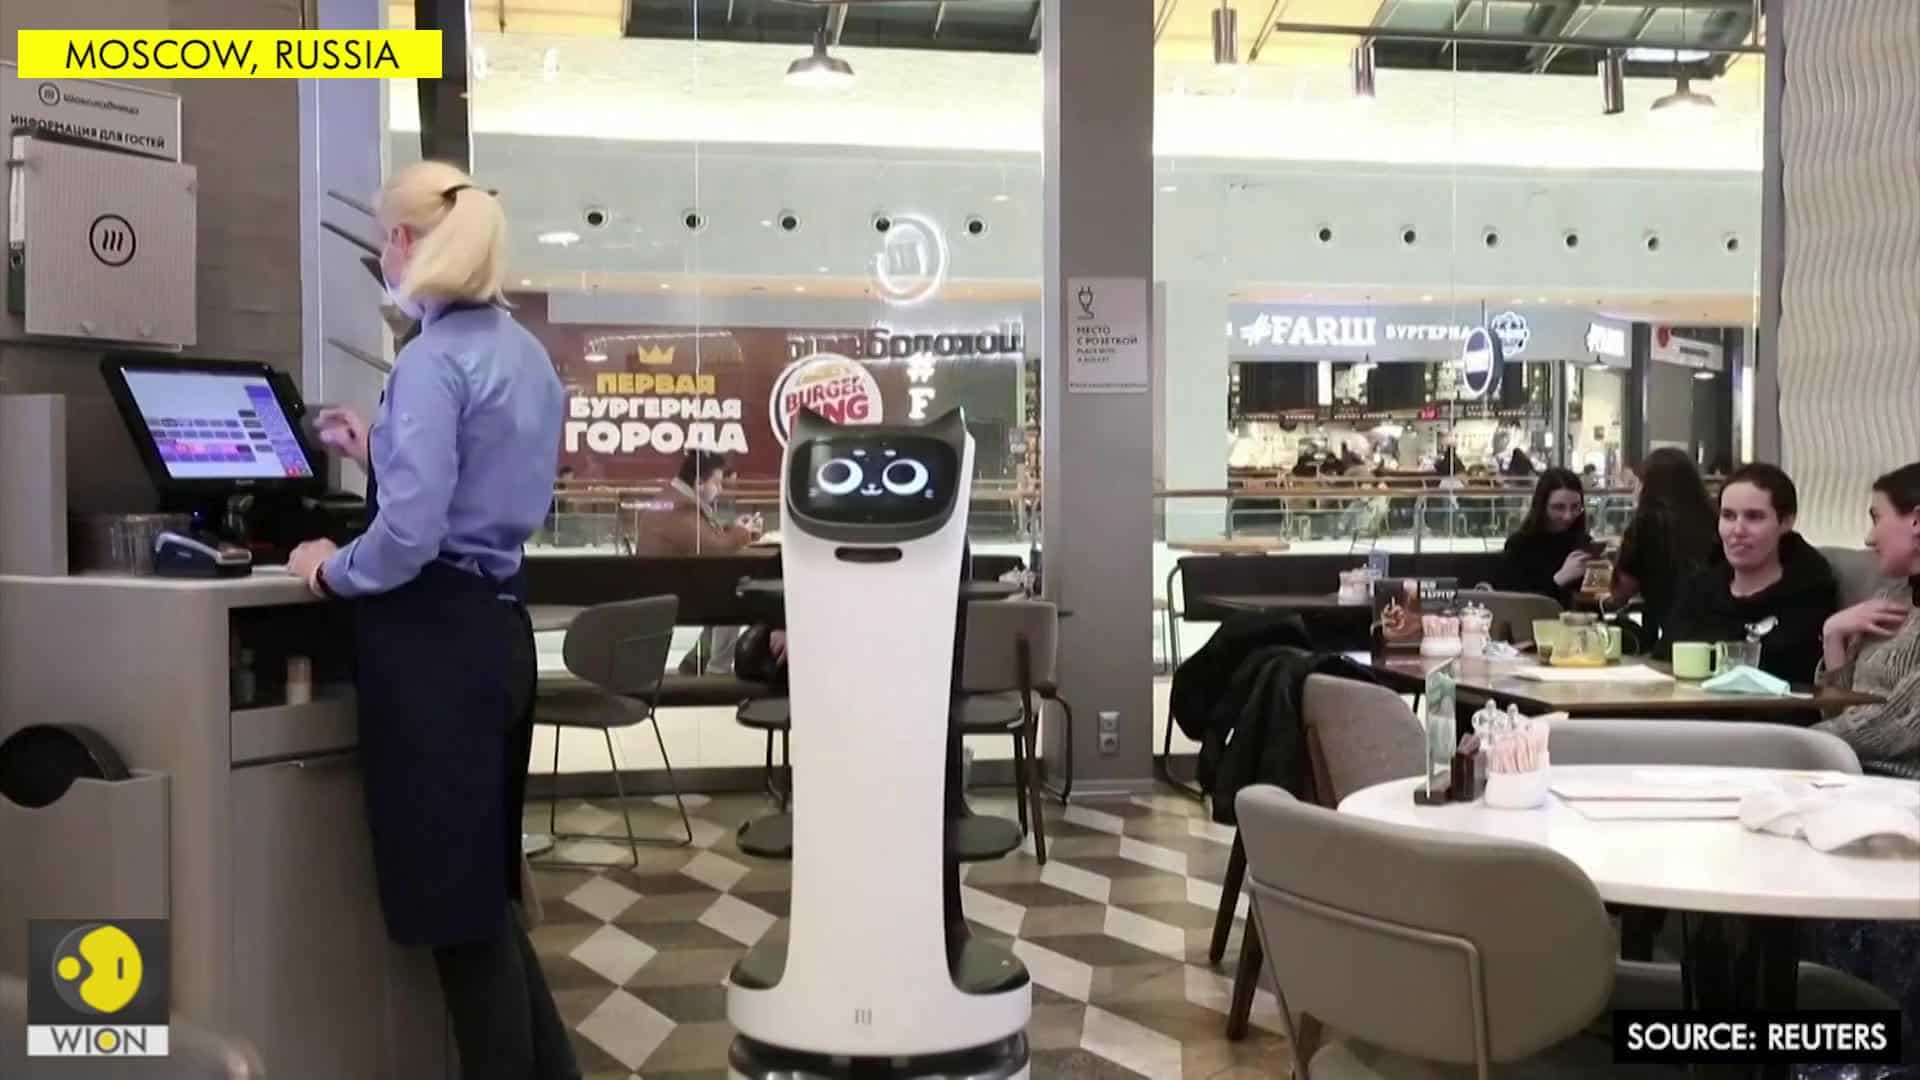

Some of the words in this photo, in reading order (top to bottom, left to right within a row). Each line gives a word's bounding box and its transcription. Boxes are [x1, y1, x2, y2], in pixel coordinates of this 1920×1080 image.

[10, 113, 98, 138] ИНФОРМАЦИЯ
[100, 129, 125, 143] ДЛЯ
[125, 132, 166, 149] ГОСТЕЙ
[596, 372, 716, 395] ПЕРВАЯ
[785, 376, 865, 414] BURGER
[570, 396, 743, 420] БУРГЕРНАЯ
[564, 421, 749, 455] ГОРОДА
